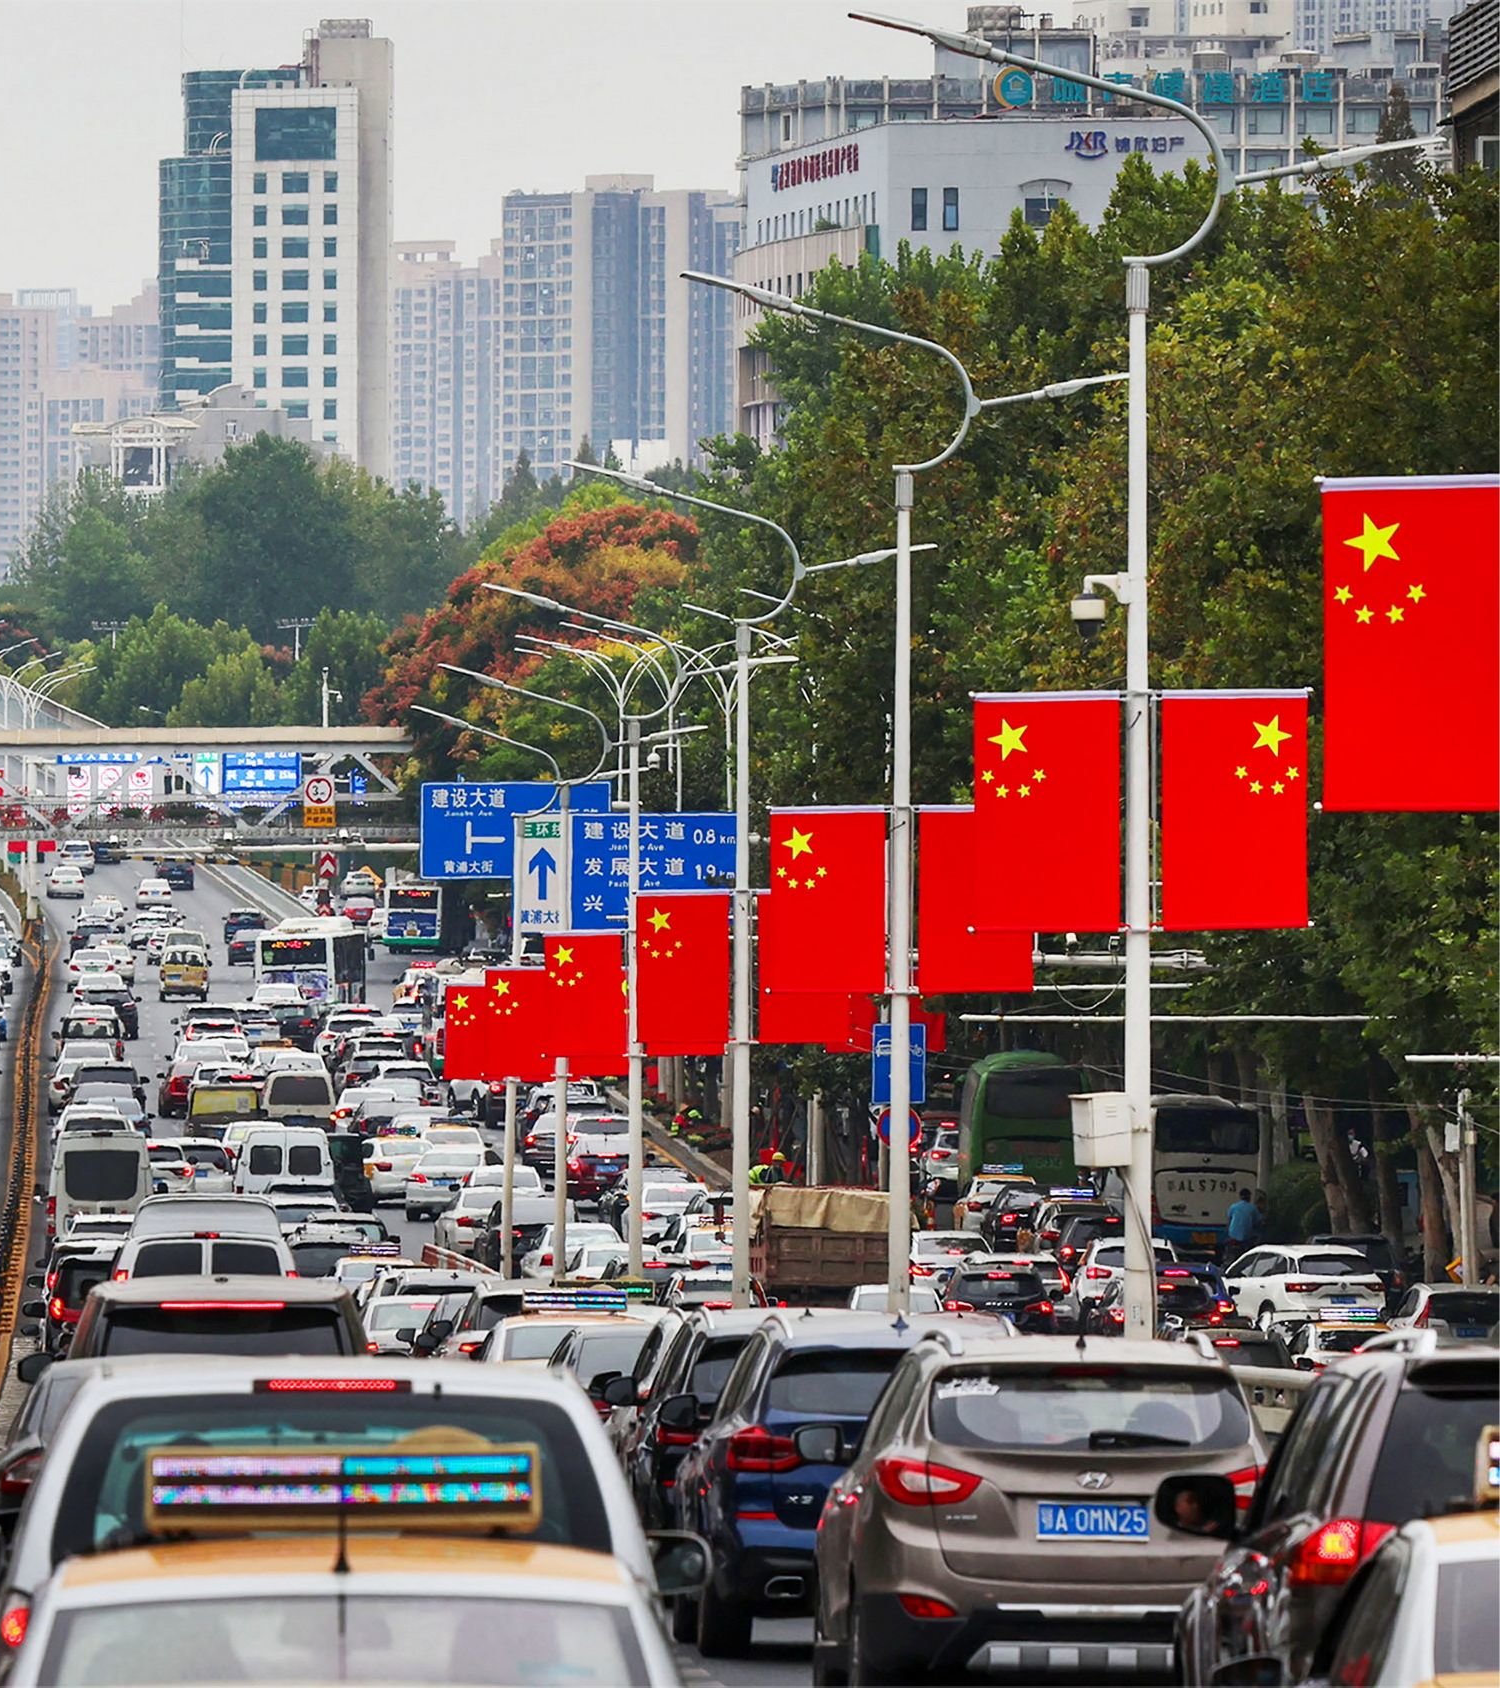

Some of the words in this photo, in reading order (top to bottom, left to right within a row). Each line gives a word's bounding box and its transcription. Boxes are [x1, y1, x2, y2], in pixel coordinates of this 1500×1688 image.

[431, 787, 506, 808] 建设大道
[583, 821, 686, 840] 建设大道
[693, 829, 717, 845] 0.8
[608, 843, 645, 852] Jiane
[443, 860, 493, 874] 黄浦大街
[583, 857, 685, 876] 发展大道
[694, 863, 717, 881] 1.9
